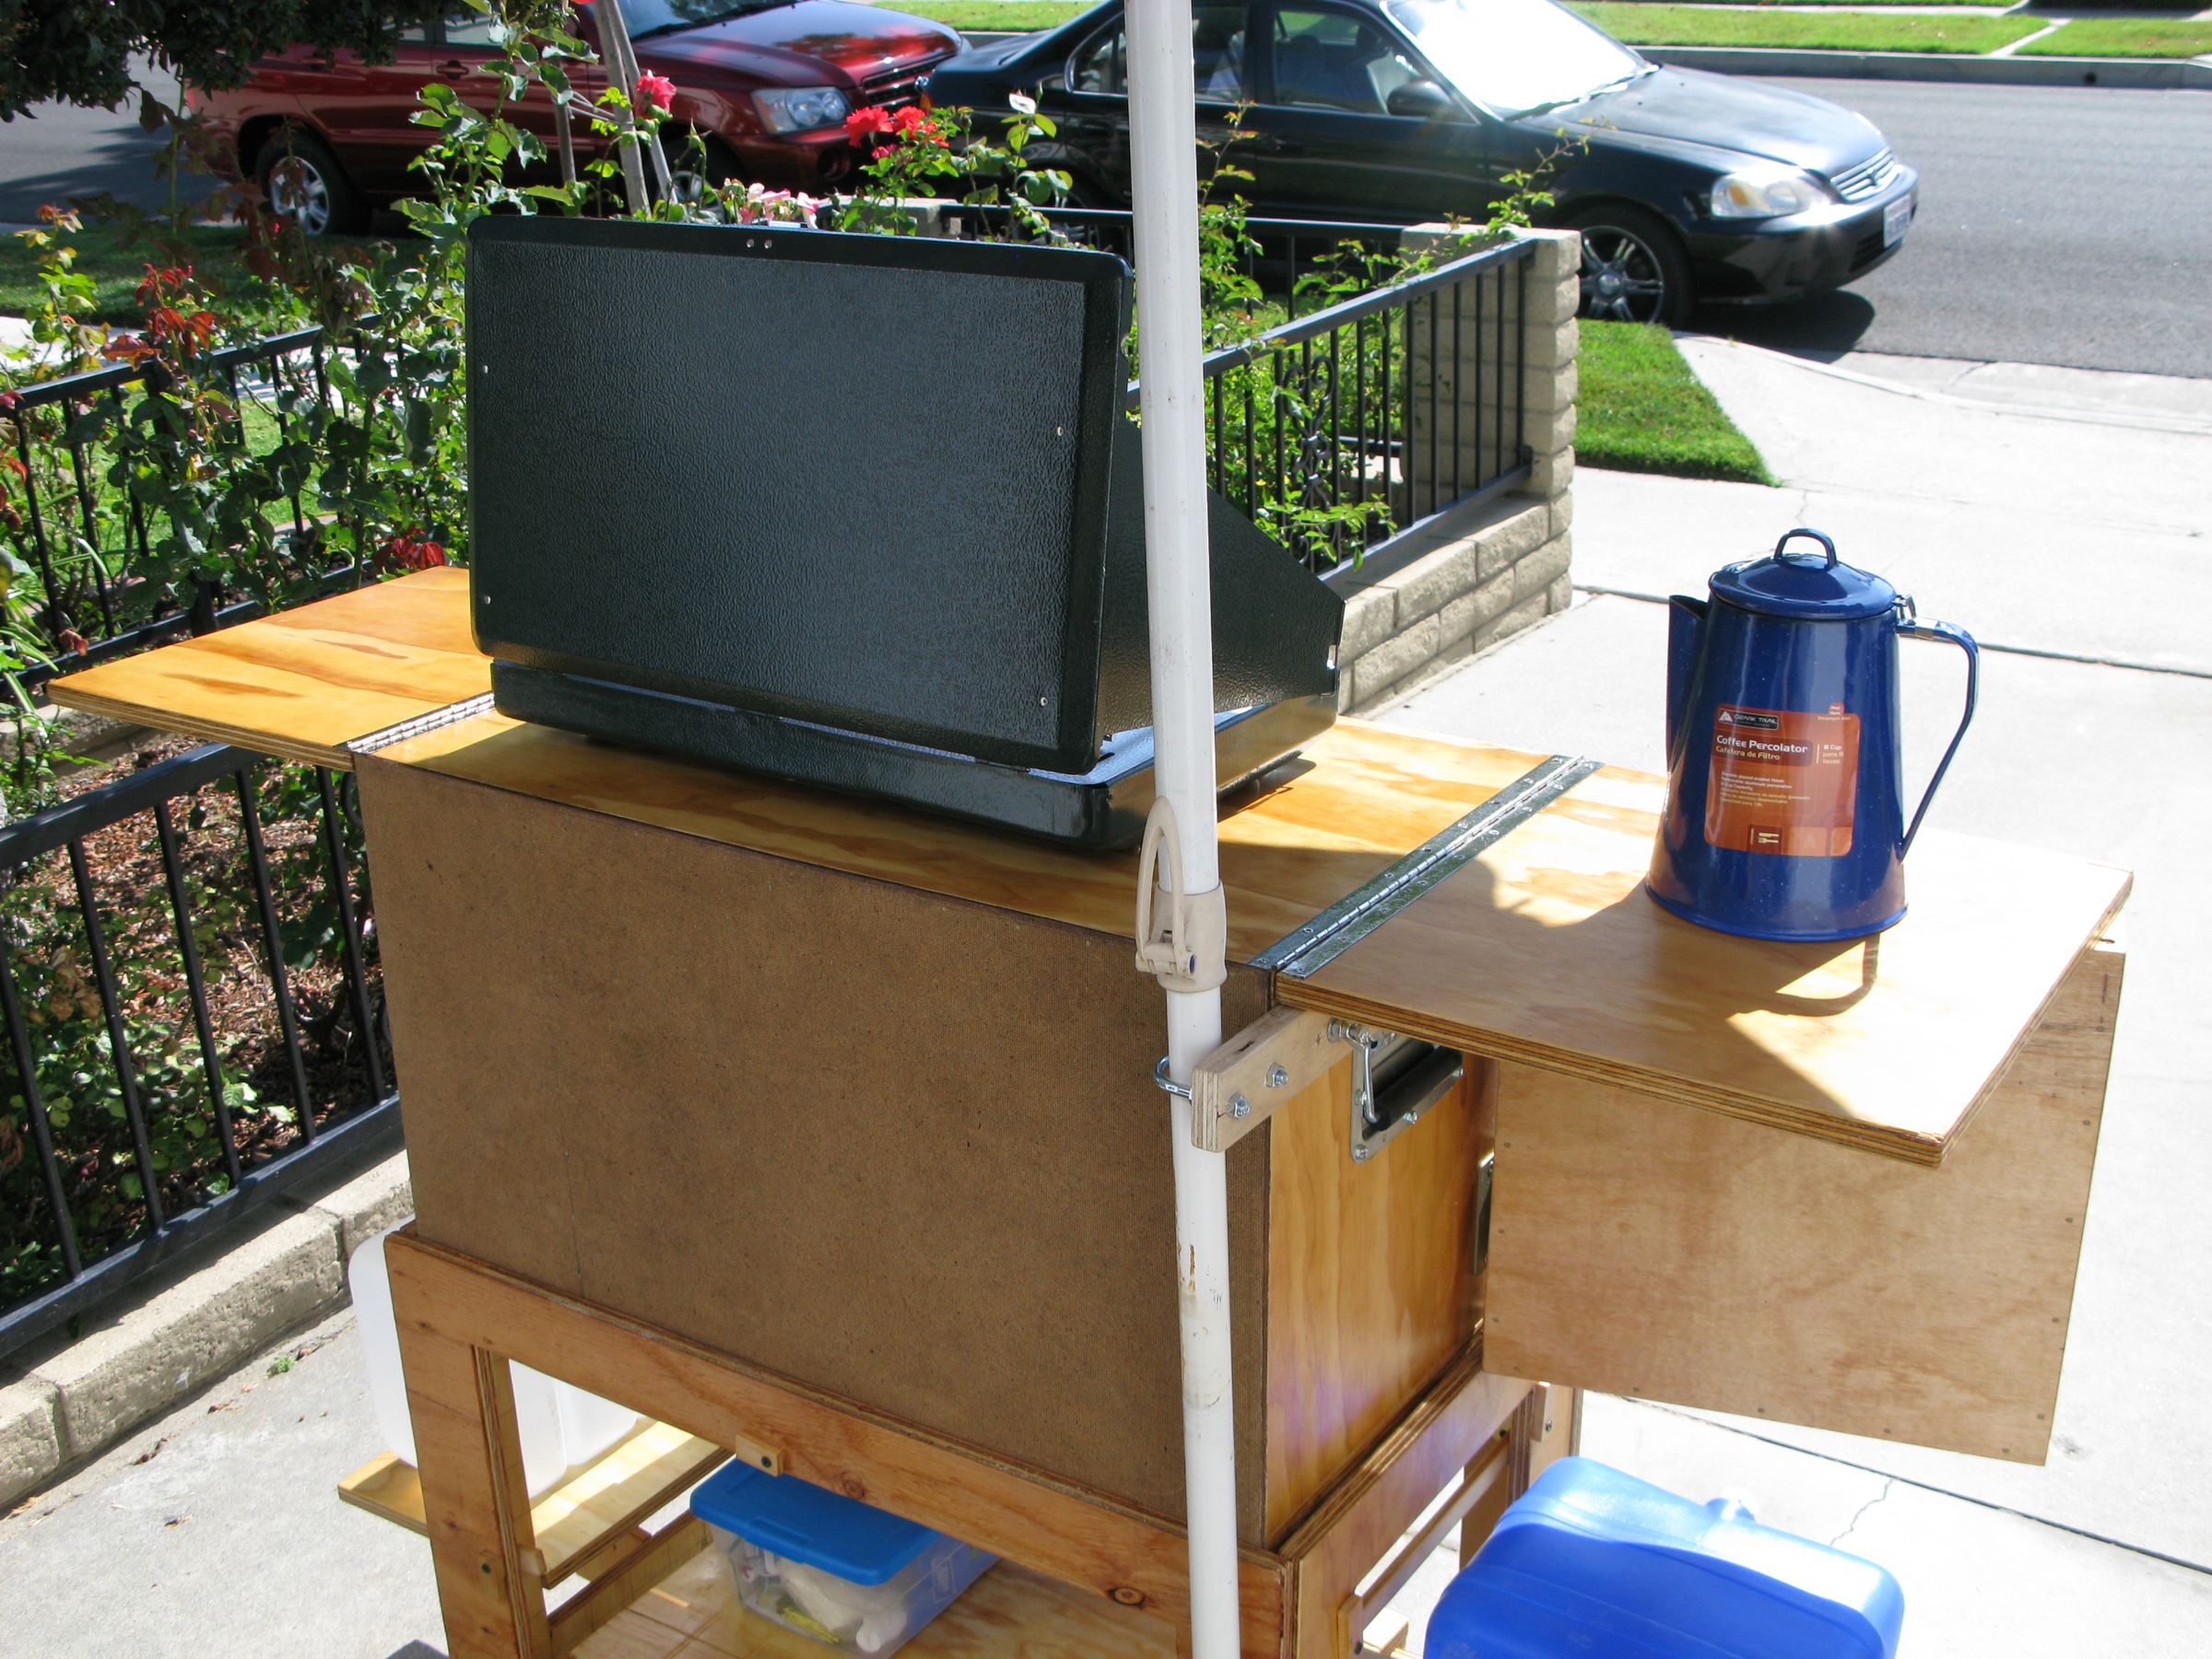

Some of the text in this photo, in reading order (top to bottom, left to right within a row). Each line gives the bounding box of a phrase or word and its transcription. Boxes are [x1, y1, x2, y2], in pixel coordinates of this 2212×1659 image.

[1716, 735, 1808, 753] Coffee Percolator
[1715, 745, 1781, 760] Cafetera de Filtro
